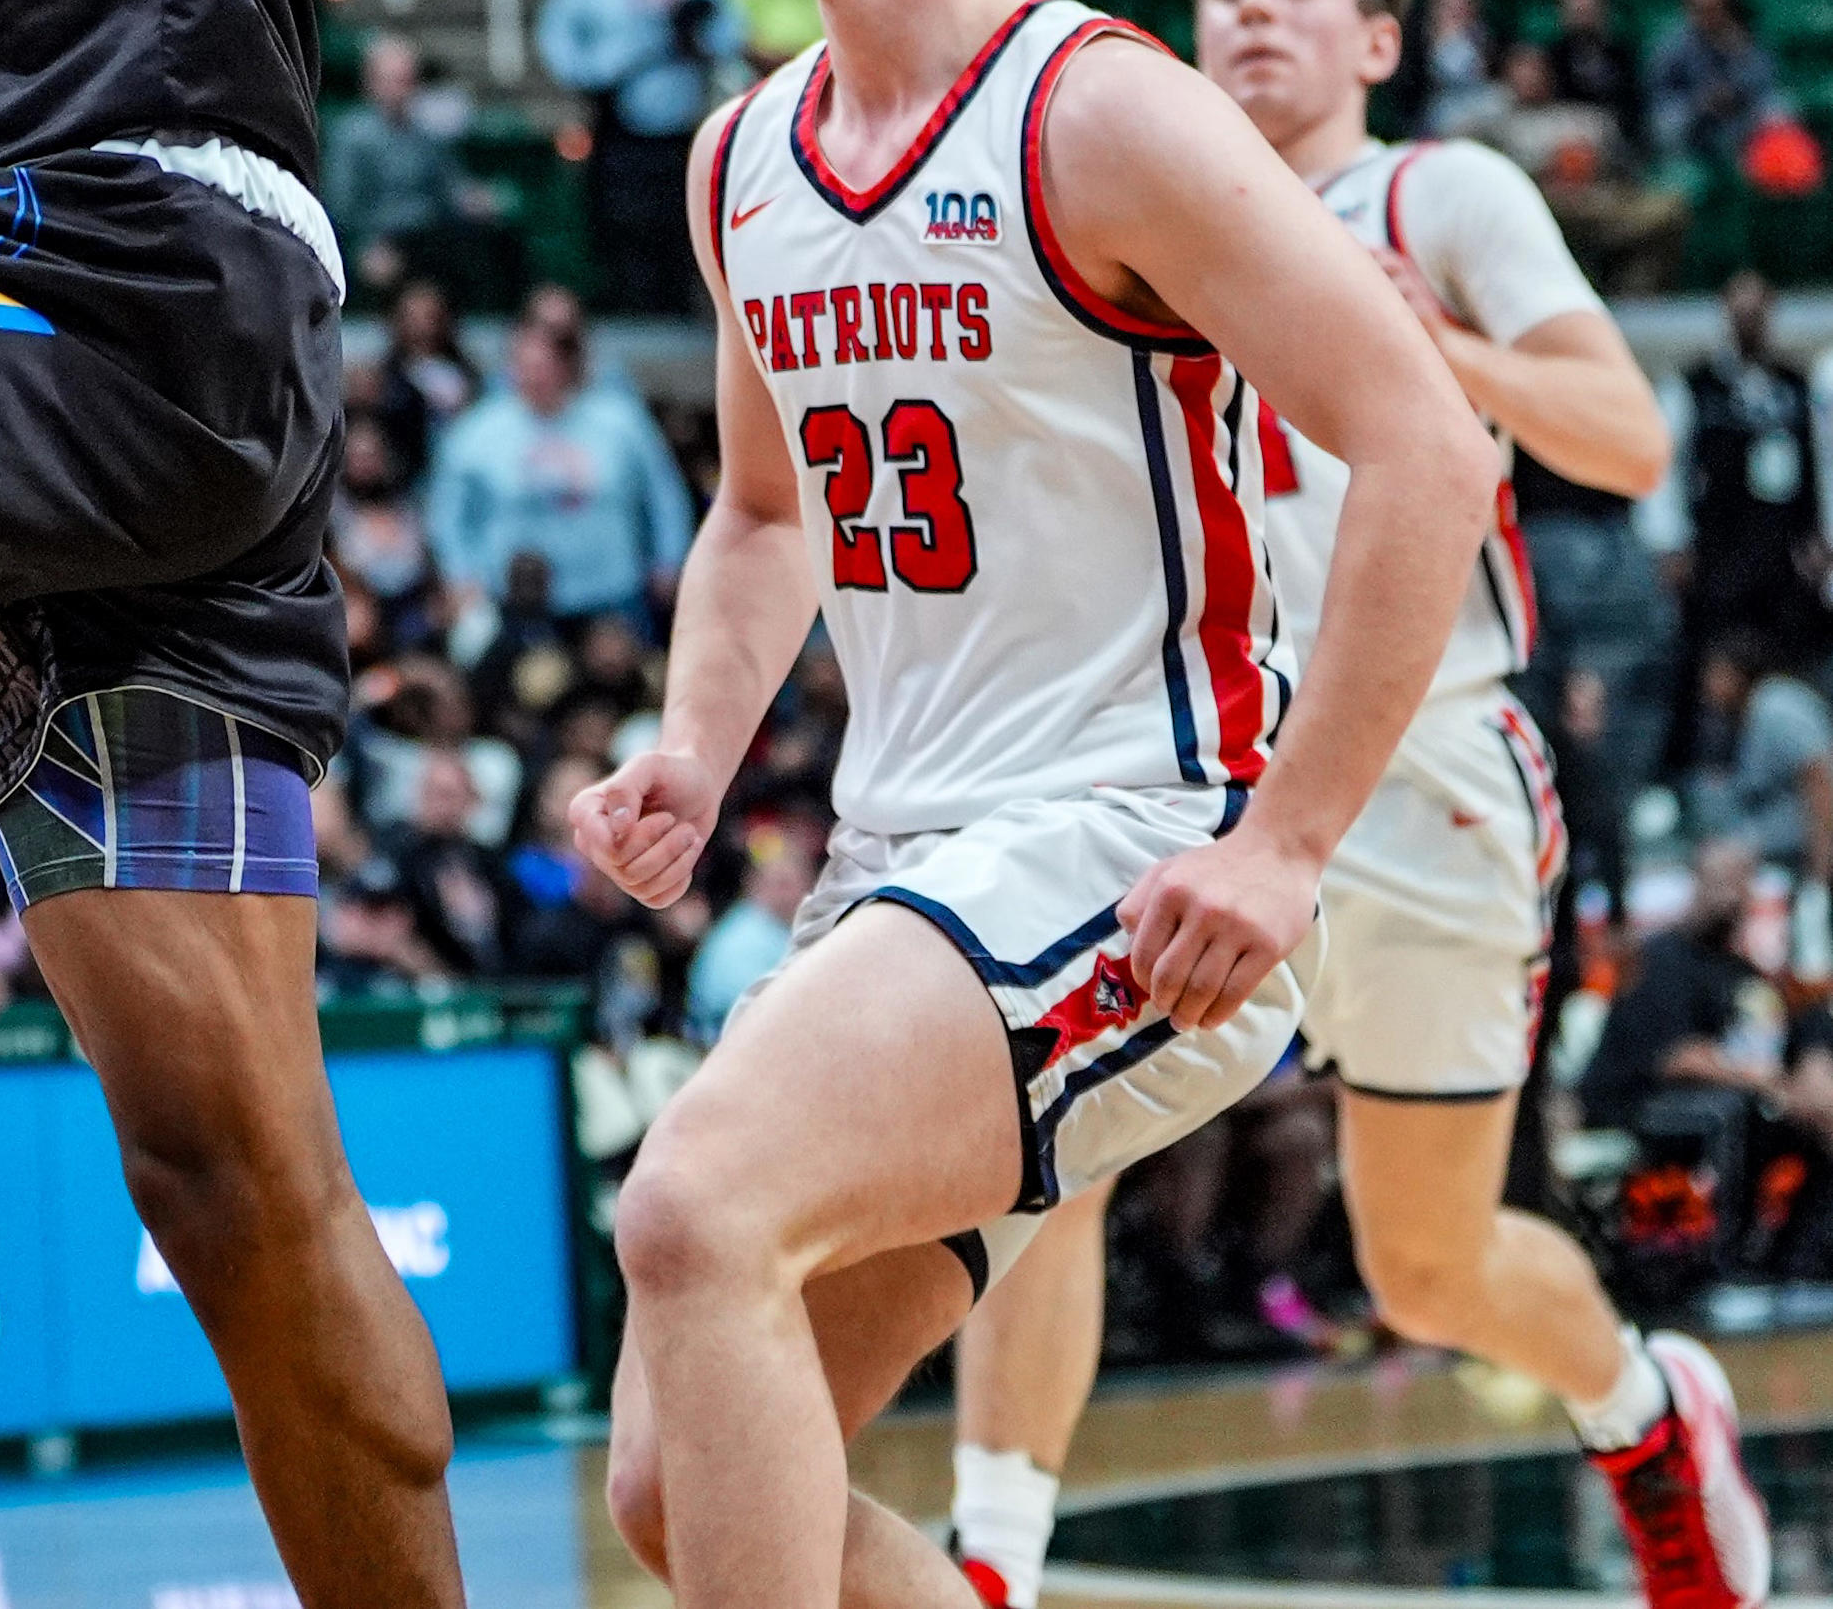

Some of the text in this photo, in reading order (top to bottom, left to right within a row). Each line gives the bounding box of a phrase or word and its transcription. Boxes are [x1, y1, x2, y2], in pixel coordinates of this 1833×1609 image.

[925, 192, 997, 233] 100
[743, 283, 993, 372] PATRIOTS
[799, 399, 978, 593] 23
